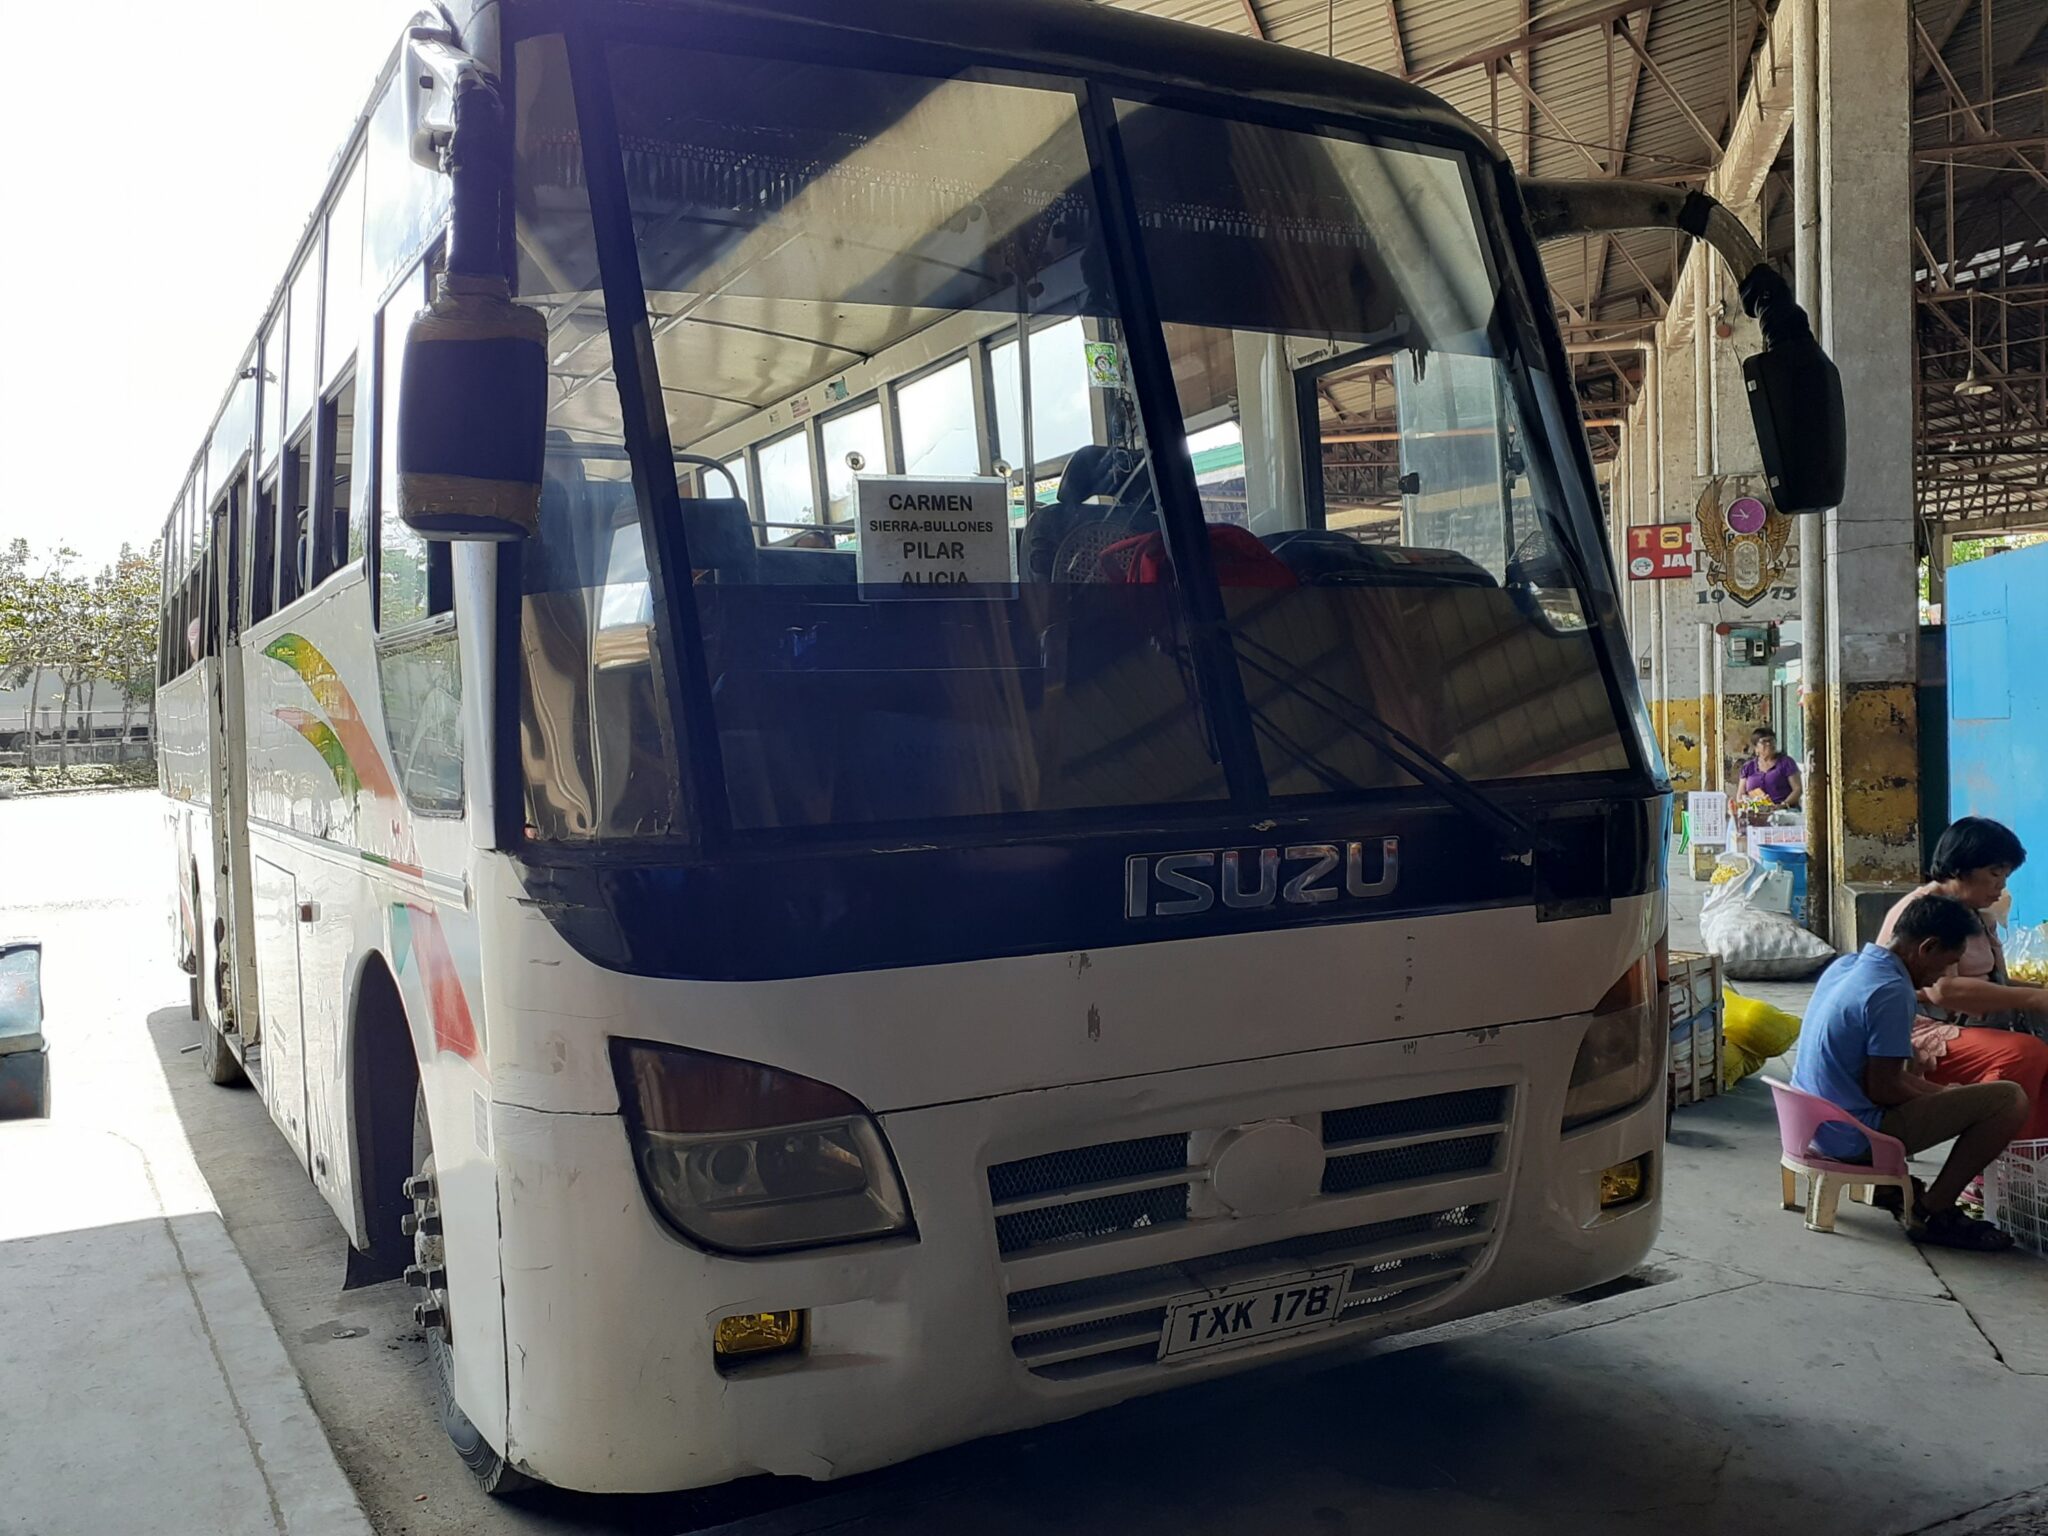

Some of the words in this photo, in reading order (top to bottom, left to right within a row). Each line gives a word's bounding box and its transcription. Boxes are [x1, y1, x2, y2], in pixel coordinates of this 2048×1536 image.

[888, 493, 973, 511] CARMEN
[869, 520, 993, 532] SIERRA-BULLONES
[903, 541, 965, 559] PILAR
[902, 571, 969, 588] ALICIA
[1696, 590, 1725, 604] 19
[1127, 837, 1399, 918] ISUZU
[1188, 1297, 1258, 1342] TXK
[1271, 1284, 1333, 1324] 178
